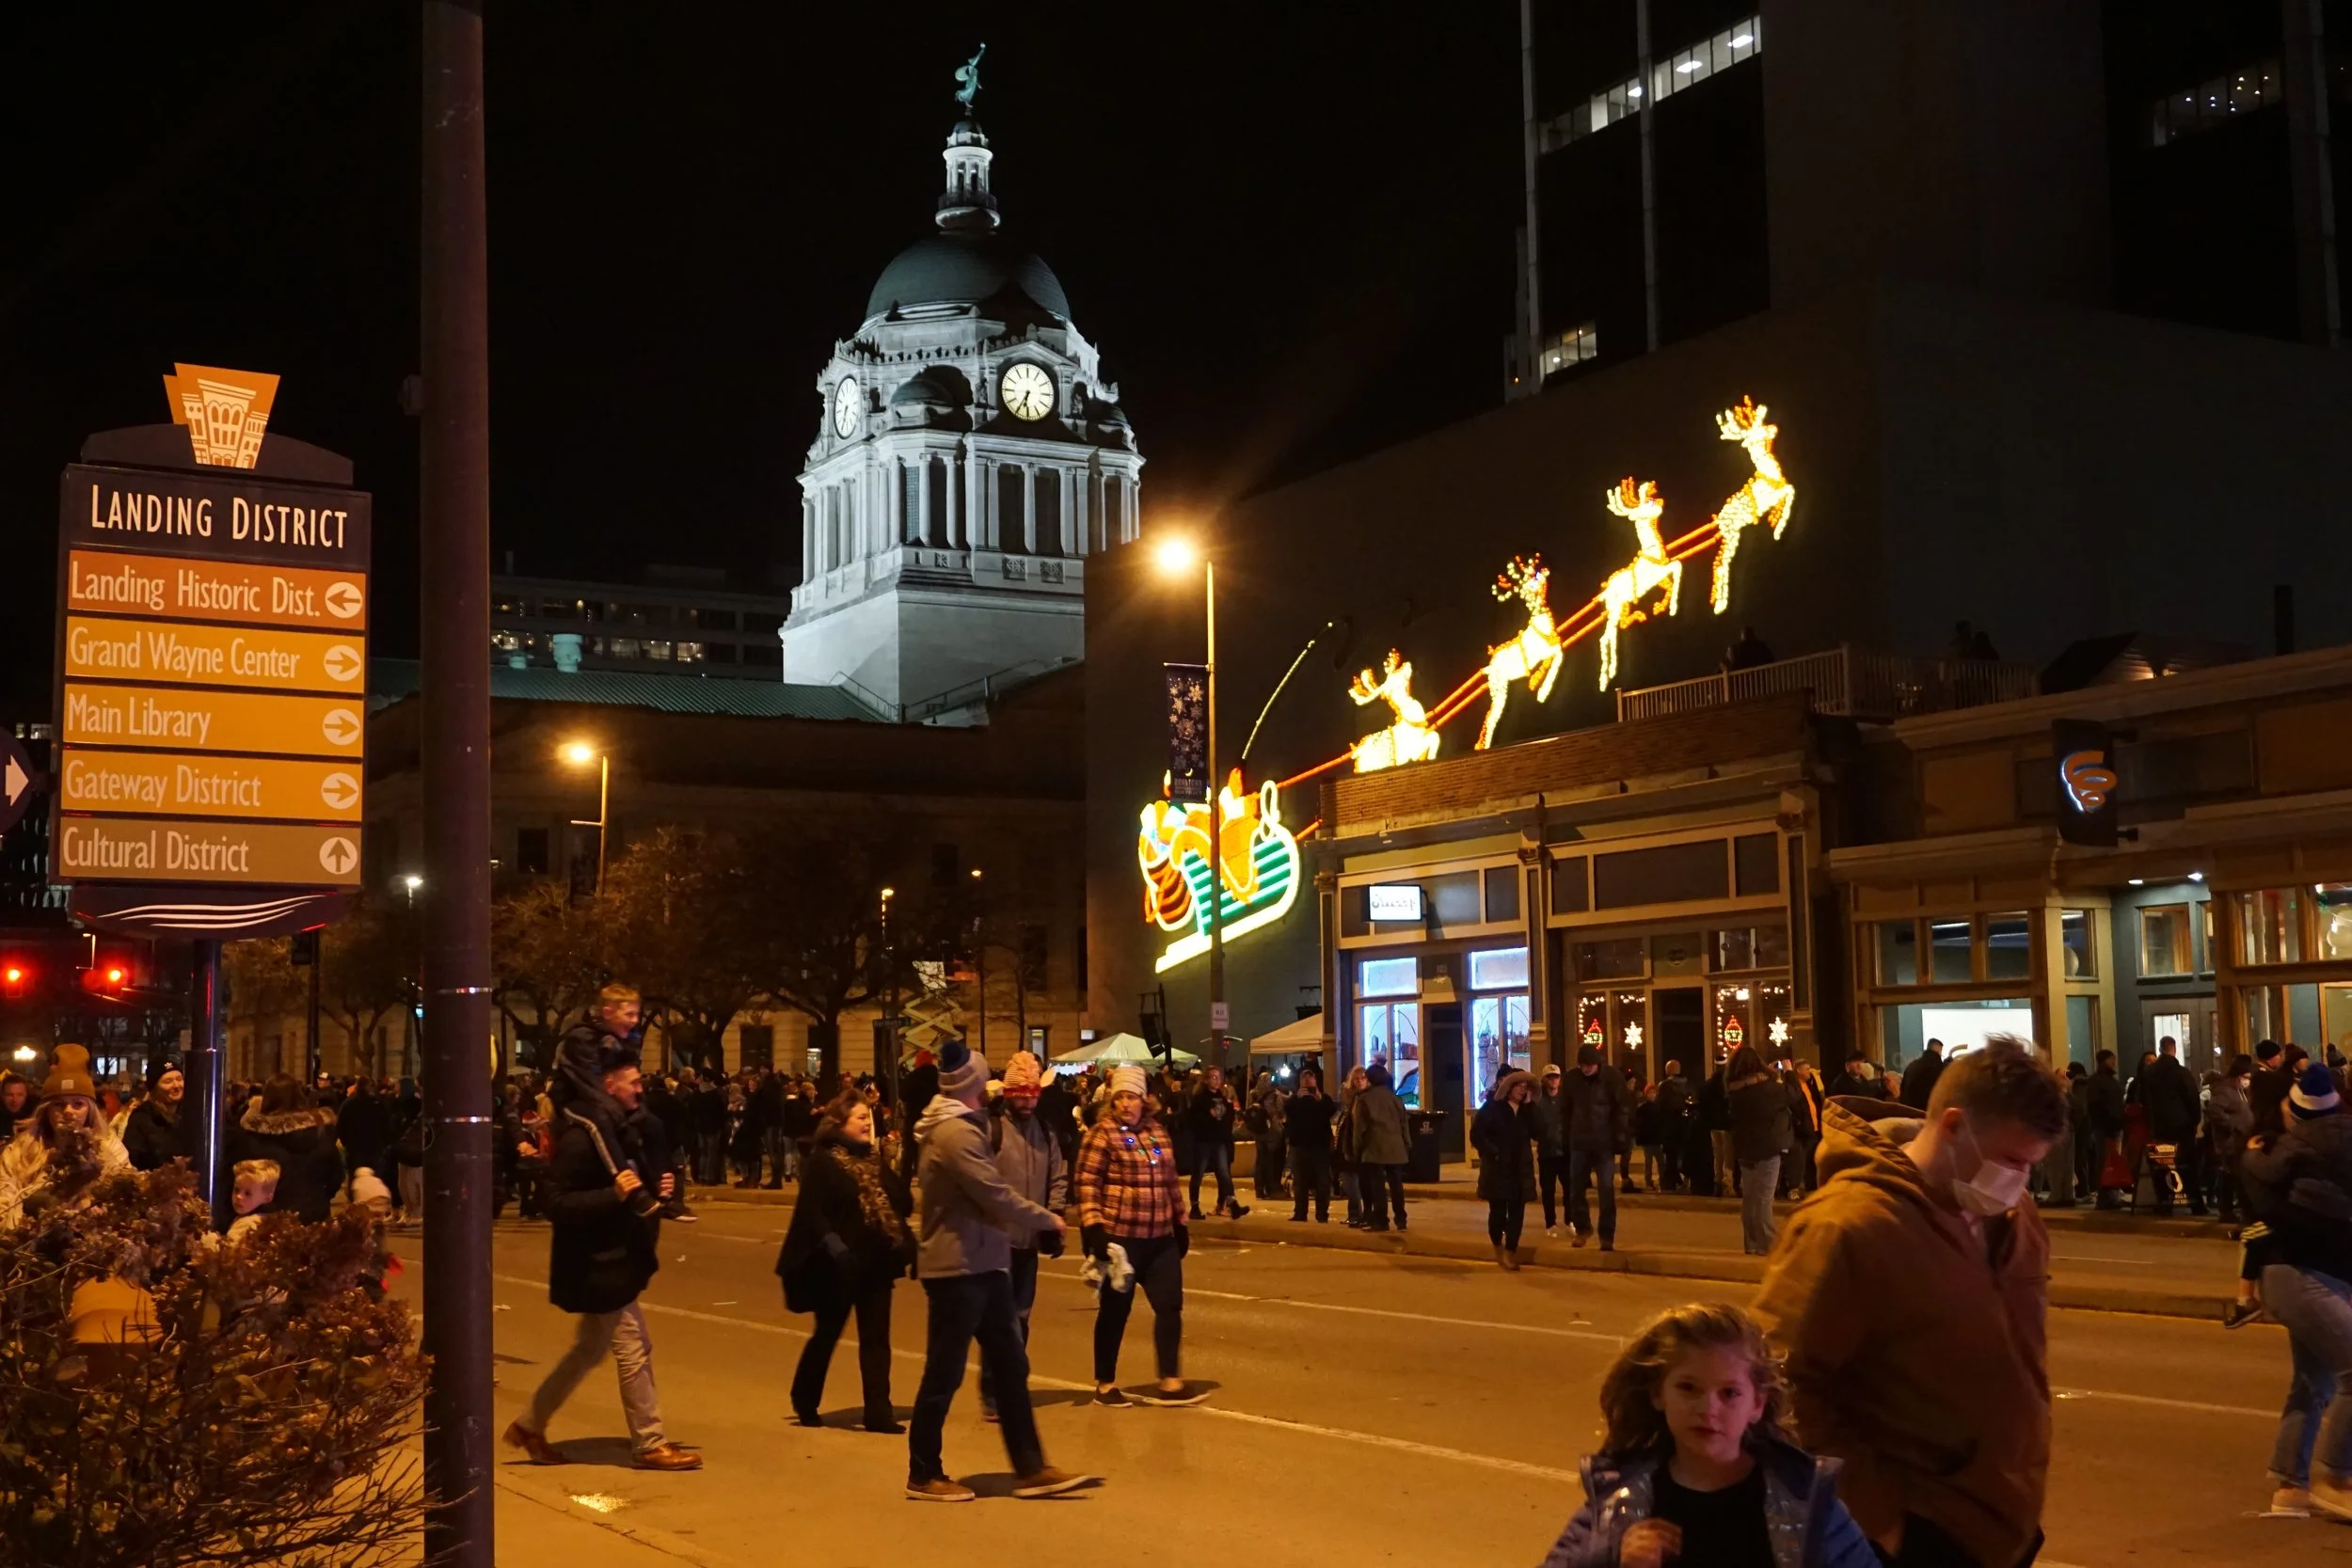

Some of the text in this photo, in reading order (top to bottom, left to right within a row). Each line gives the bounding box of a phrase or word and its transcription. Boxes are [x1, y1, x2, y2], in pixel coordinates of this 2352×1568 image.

[92, 484, 347, 548] LANDING DISTRICT
[72, 561, 321, 617] Landing Historic Dist.
[71, 626, 300, 678] Grand Wayne Center
[68, 692, 211, 744] Main Library
[65, 759, 261, 808] Gateway District
[63, 826, 249, 873] Cultural District
